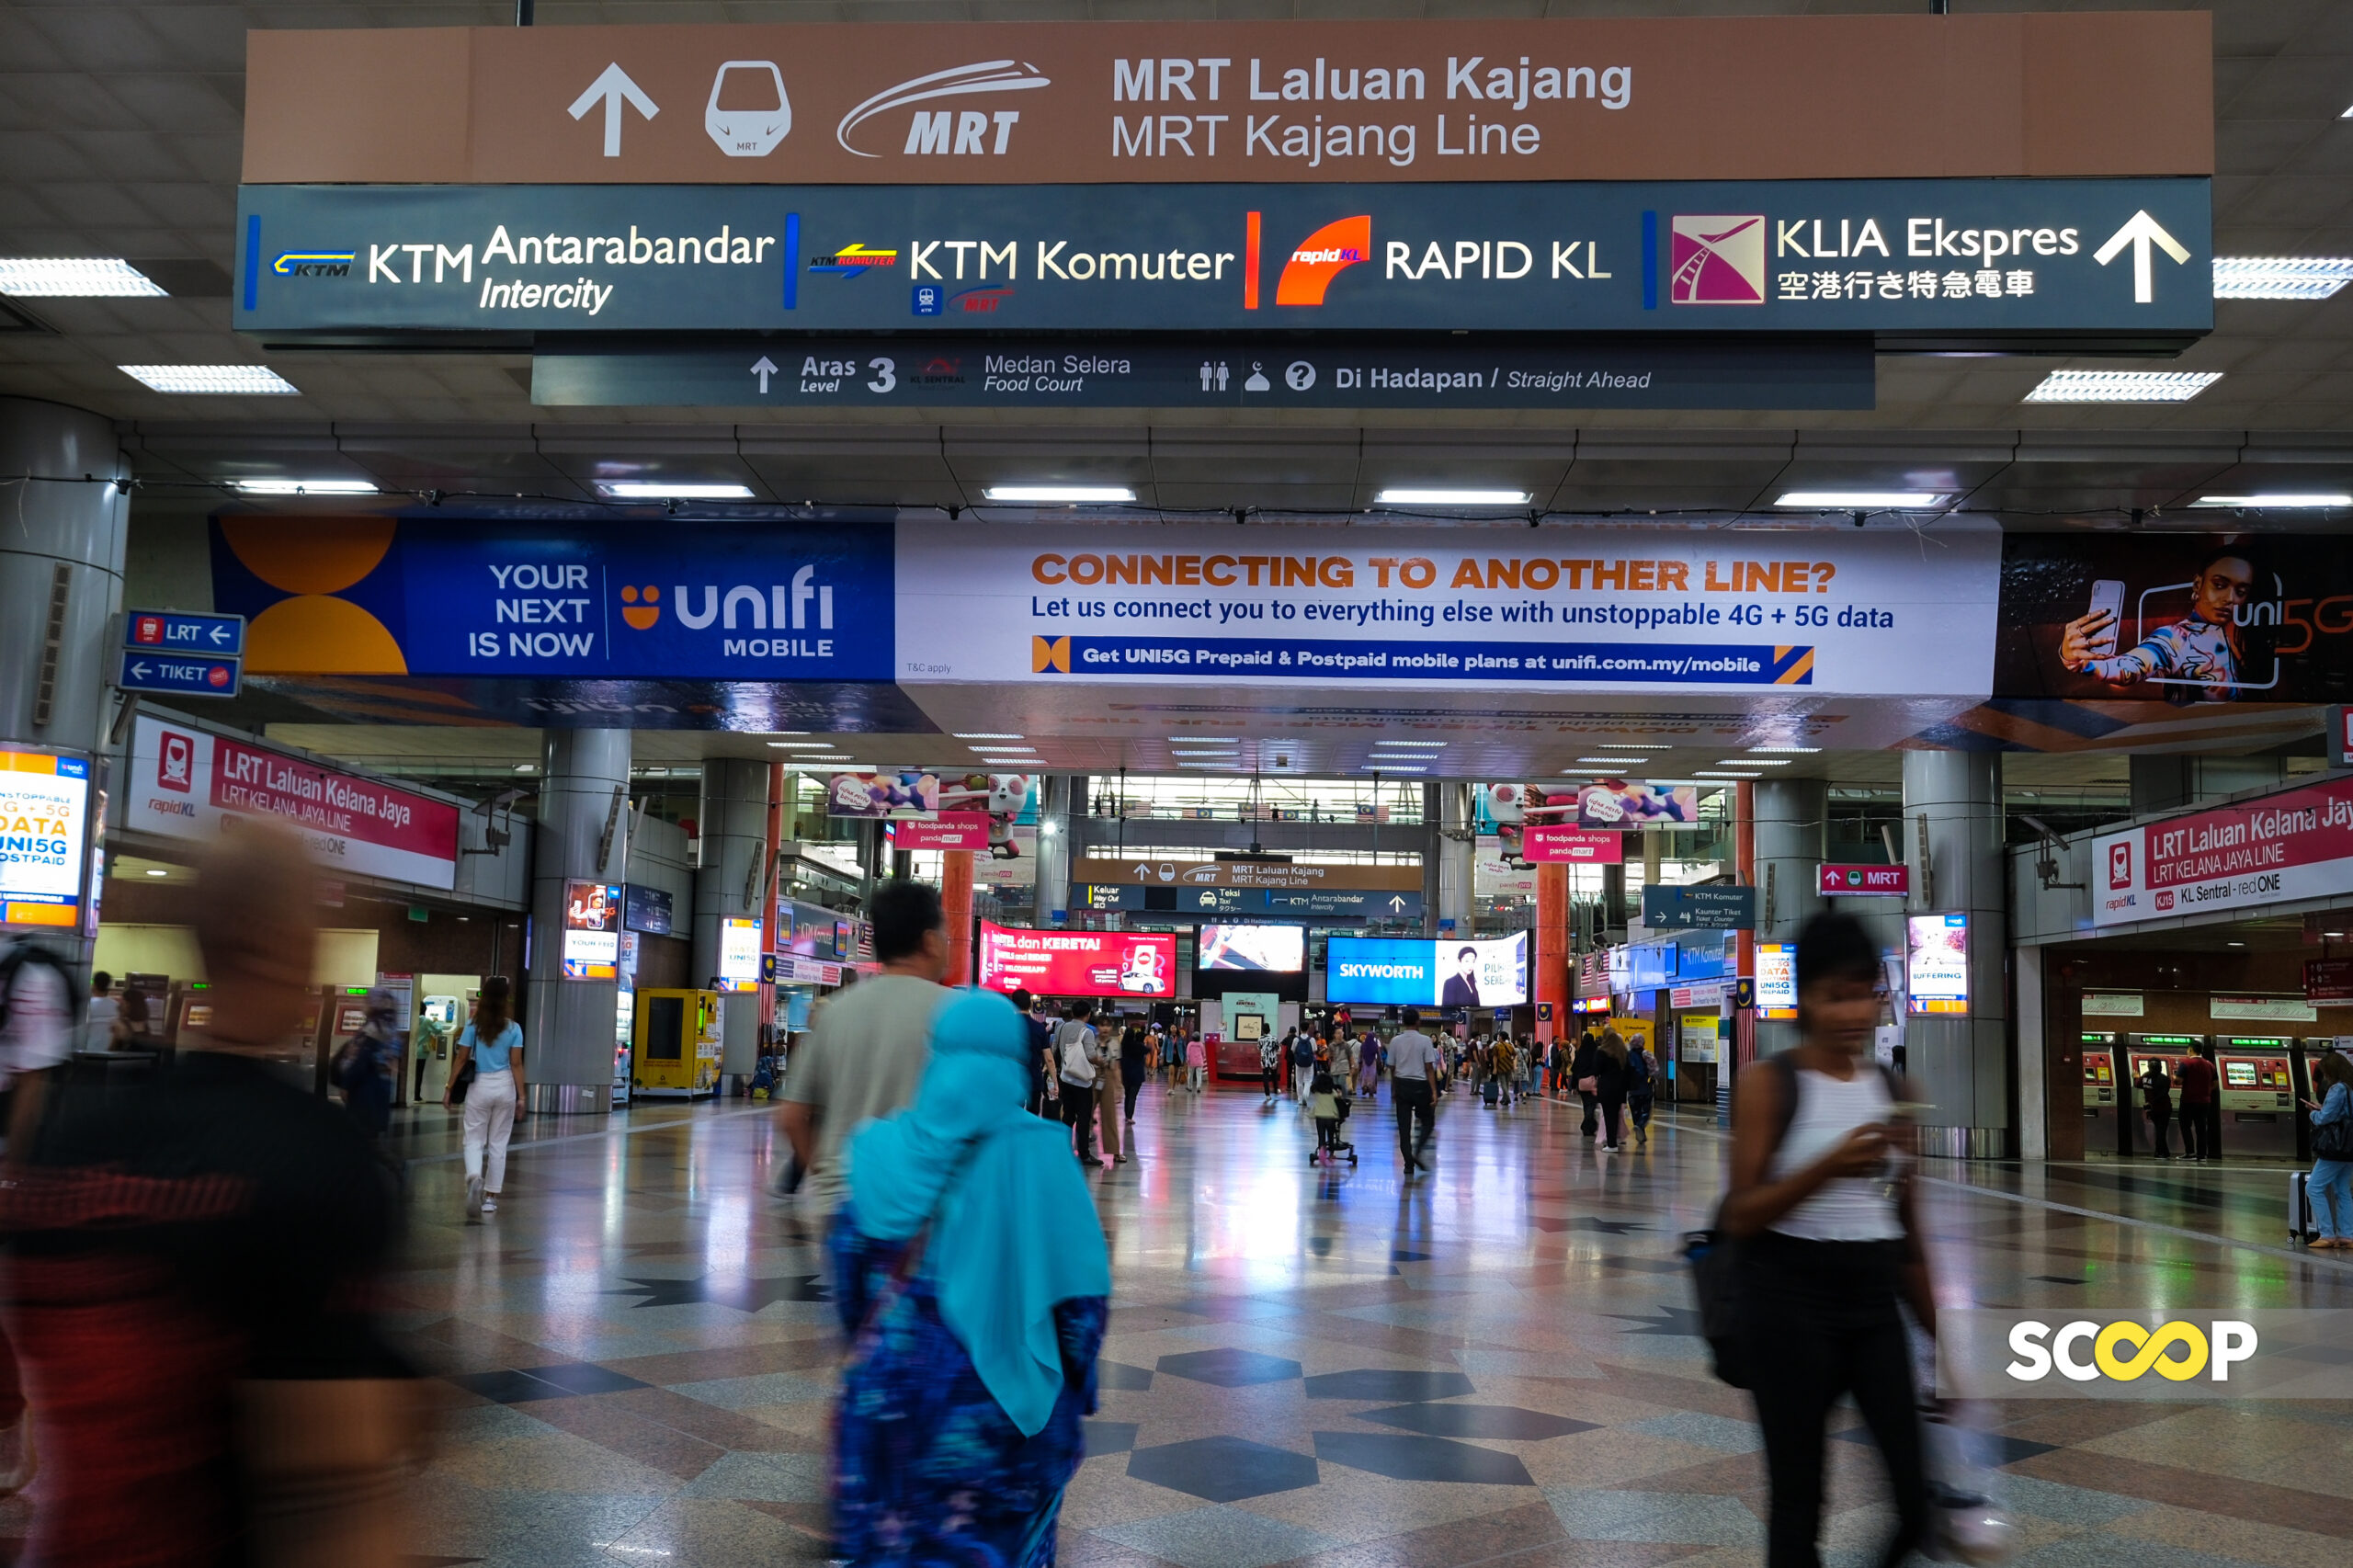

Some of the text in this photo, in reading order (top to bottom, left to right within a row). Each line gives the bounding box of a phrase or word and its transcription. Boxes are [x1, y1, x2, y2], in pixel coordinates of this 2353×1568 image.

[1113, 56, 1631, 110] MRT Laluan Kajang
[904, 111, 1020, 154] MRT
[1112, 113, 1540, 167] MRT Kajang Line
[736, 142, 758, 152] MRT
[481, 224, 776, 265] Antarabandar
[1777, 217, 2080, 267] KLIA Ekspres
[369, 244, 473, 284] KTM
[810, 255, 897, 267] KTM KOMUTER
[910, 240, 1235, 280] KTM Komuter
[1291, 248, 1362, 265] rapidKL
[1385, 240, 1613, 280] RAPID KL
[293, 264, 352, 277] KTM
[1777, 269, 2034, 301] 空港行き特急電車
[480, 277, 614, 316] Intercity
[964, 298, 1000, 312] MRT
[801, 356, 856, 376] Aras
[984, 355, 1131, 374] Medan Selera
[867, 357, 897, 393] 3
[983, 376, 1084, 392] Food Court
[1336, 367, 1652, 392] Di Hadapan / Straight Ahead
[801, 379, 840, 392] Level
[489, 564, 588, 589] YOUR
[1031, 553, 1836, 594] CONNECTING TO ANOTHER LINE?
[674, 563, 834, 631] unifi
[495, 598, 590, 623] NEXT
[1031, 596, 1894, 630] Let us connect you to everything else with unstoppable 4G + 5G data
[166, 623, 201, 641] LRT
[469, 632, 595, 657] IS NOW
[723, 639, 834, 657] MOBILE
[906, 663, 925, 672] T&C
[1083, 647, 1760, 674] Get UNI5G Prepaid & Postpaid mobile plans at unifi.com.my/mobile
[158, 664, 207, 680] TIKET
[224, 748, 410, 828] LRT Laluan Kelana Jaya
[0, 791, 71, 804] NSTOPPABLE
[46, 804, 70, 817] 5G
[148, 797, 195, 818] rapidKL
[222, 782, 351, 832] LRT KELANA JAYA LINE
[918, 822, 978, 831] foodpanda shops
[2154, 807, 2317, 860] LRT Laluan Kelana
[0, 836, 67, 855] NI5G
[1546, 834, 1610, 845] foodpanda shops
[0, 852, 65, 866] OSTPAID
[2154, 842, 2285, 883] LRT KELANA JAYA LINE
[1195, 873, 1217, 882] MRT
[1232, 865, 1324, 878] MRT Laluan Kajang
[1232, 875, 1308, 886] MRT Kajang Line
[1867, 872, 1901, 885] MRT
[1094, 885, 1120, 894] Keluar
[1094, 894, 1120, 903] Way Out
[1219, 888, 1240, 897] Teksi
[1311, 894, 1365, 903] Antarabandar
[1695, 892, 1744, 901] KTM Komuter
[2181, 887, 2195, 903] KL
[2197, 881, 2232, 901] Sentral
[1290, 897, 1309, 905] KTM
[1310, 903, 1335, 912] Intercity
[2105, 892, 2136, 911] rapidKL
[2156, 893, 2173, 908] KJ15
[801, 921, 834, 946] KTM Komuter
[1017, 935, 1101, 950] dan KERETA!
[1688, 945, 1723, 965] KTM Komuter
[1339, 963, 1424, 979] SKYWORTH
[1760, 967, 1789, 975] DATA
[1760, 981, 1790, 989] UNI5G
